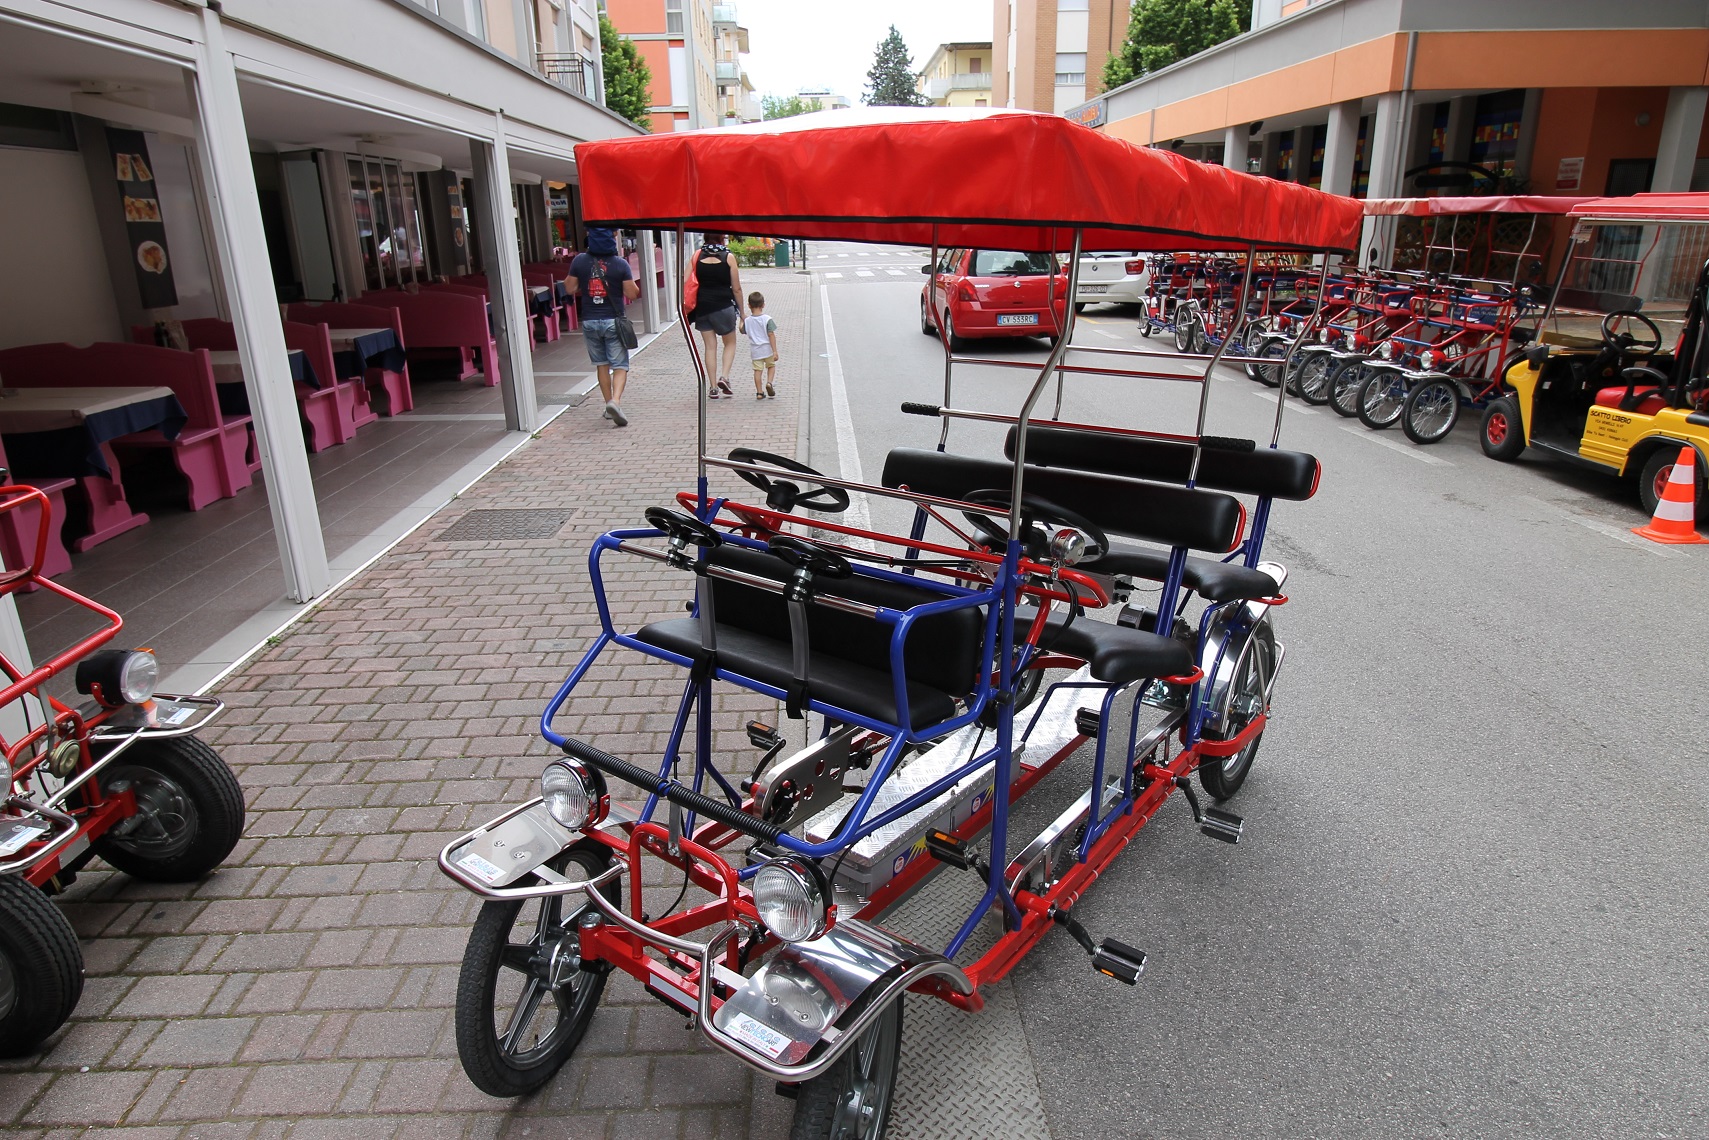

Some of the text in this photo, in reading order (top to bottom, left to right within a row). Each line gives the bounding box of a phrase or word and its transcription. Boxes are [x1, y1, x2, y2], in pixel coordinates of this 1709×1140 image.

[1013, 315, 1033, 323] 533RC
[1590, 410, 1632, 424] SCATTO LIBERO
